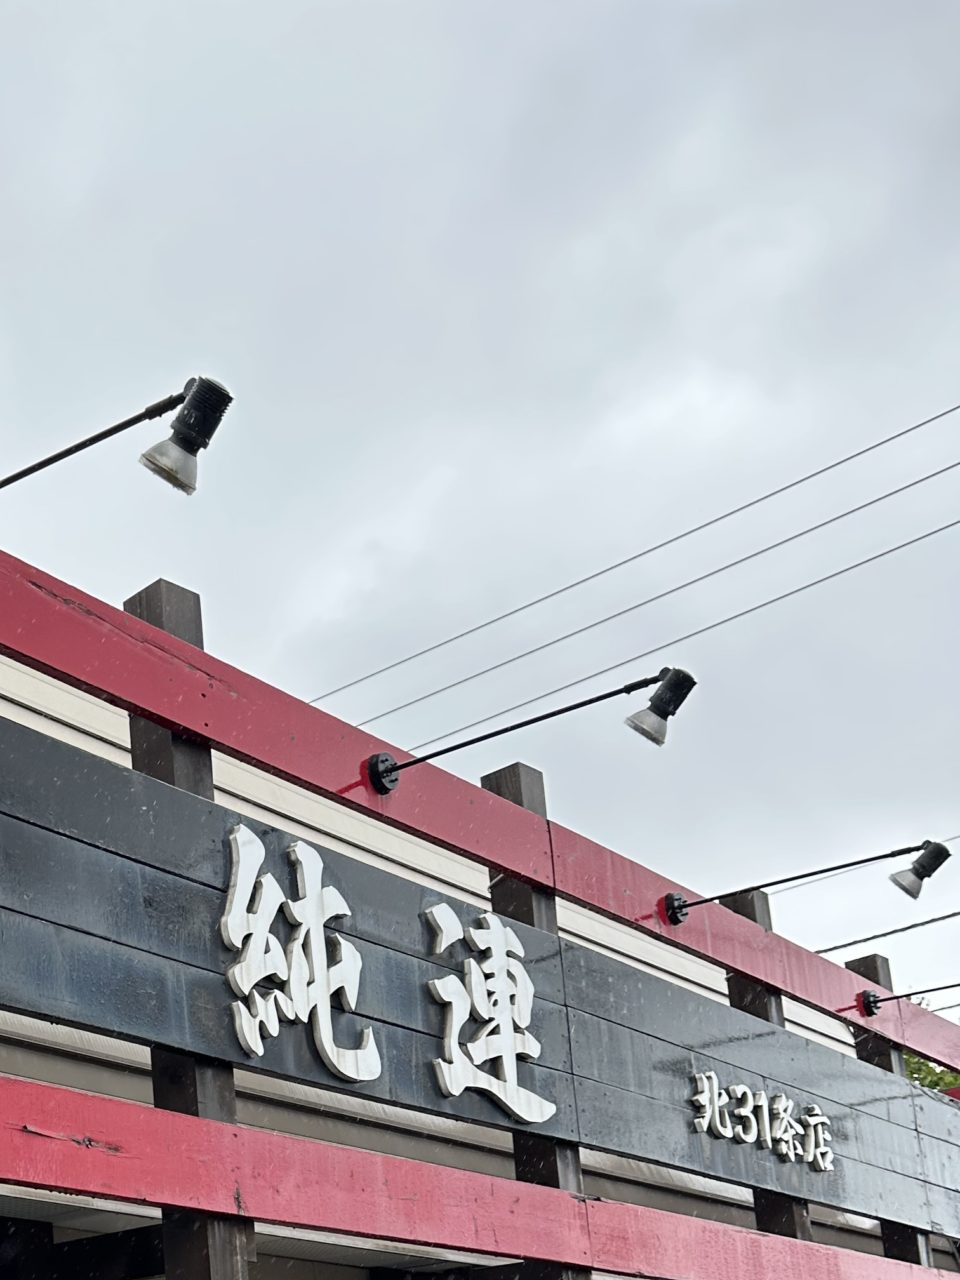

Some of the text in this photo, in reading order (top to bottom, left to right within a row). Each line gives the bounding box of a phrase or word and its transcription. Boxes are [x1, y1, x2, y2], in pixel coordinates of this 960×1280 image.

[221, 823, 557, 1123] 純連
[692, 1070, 835, 1171] 北31条店
